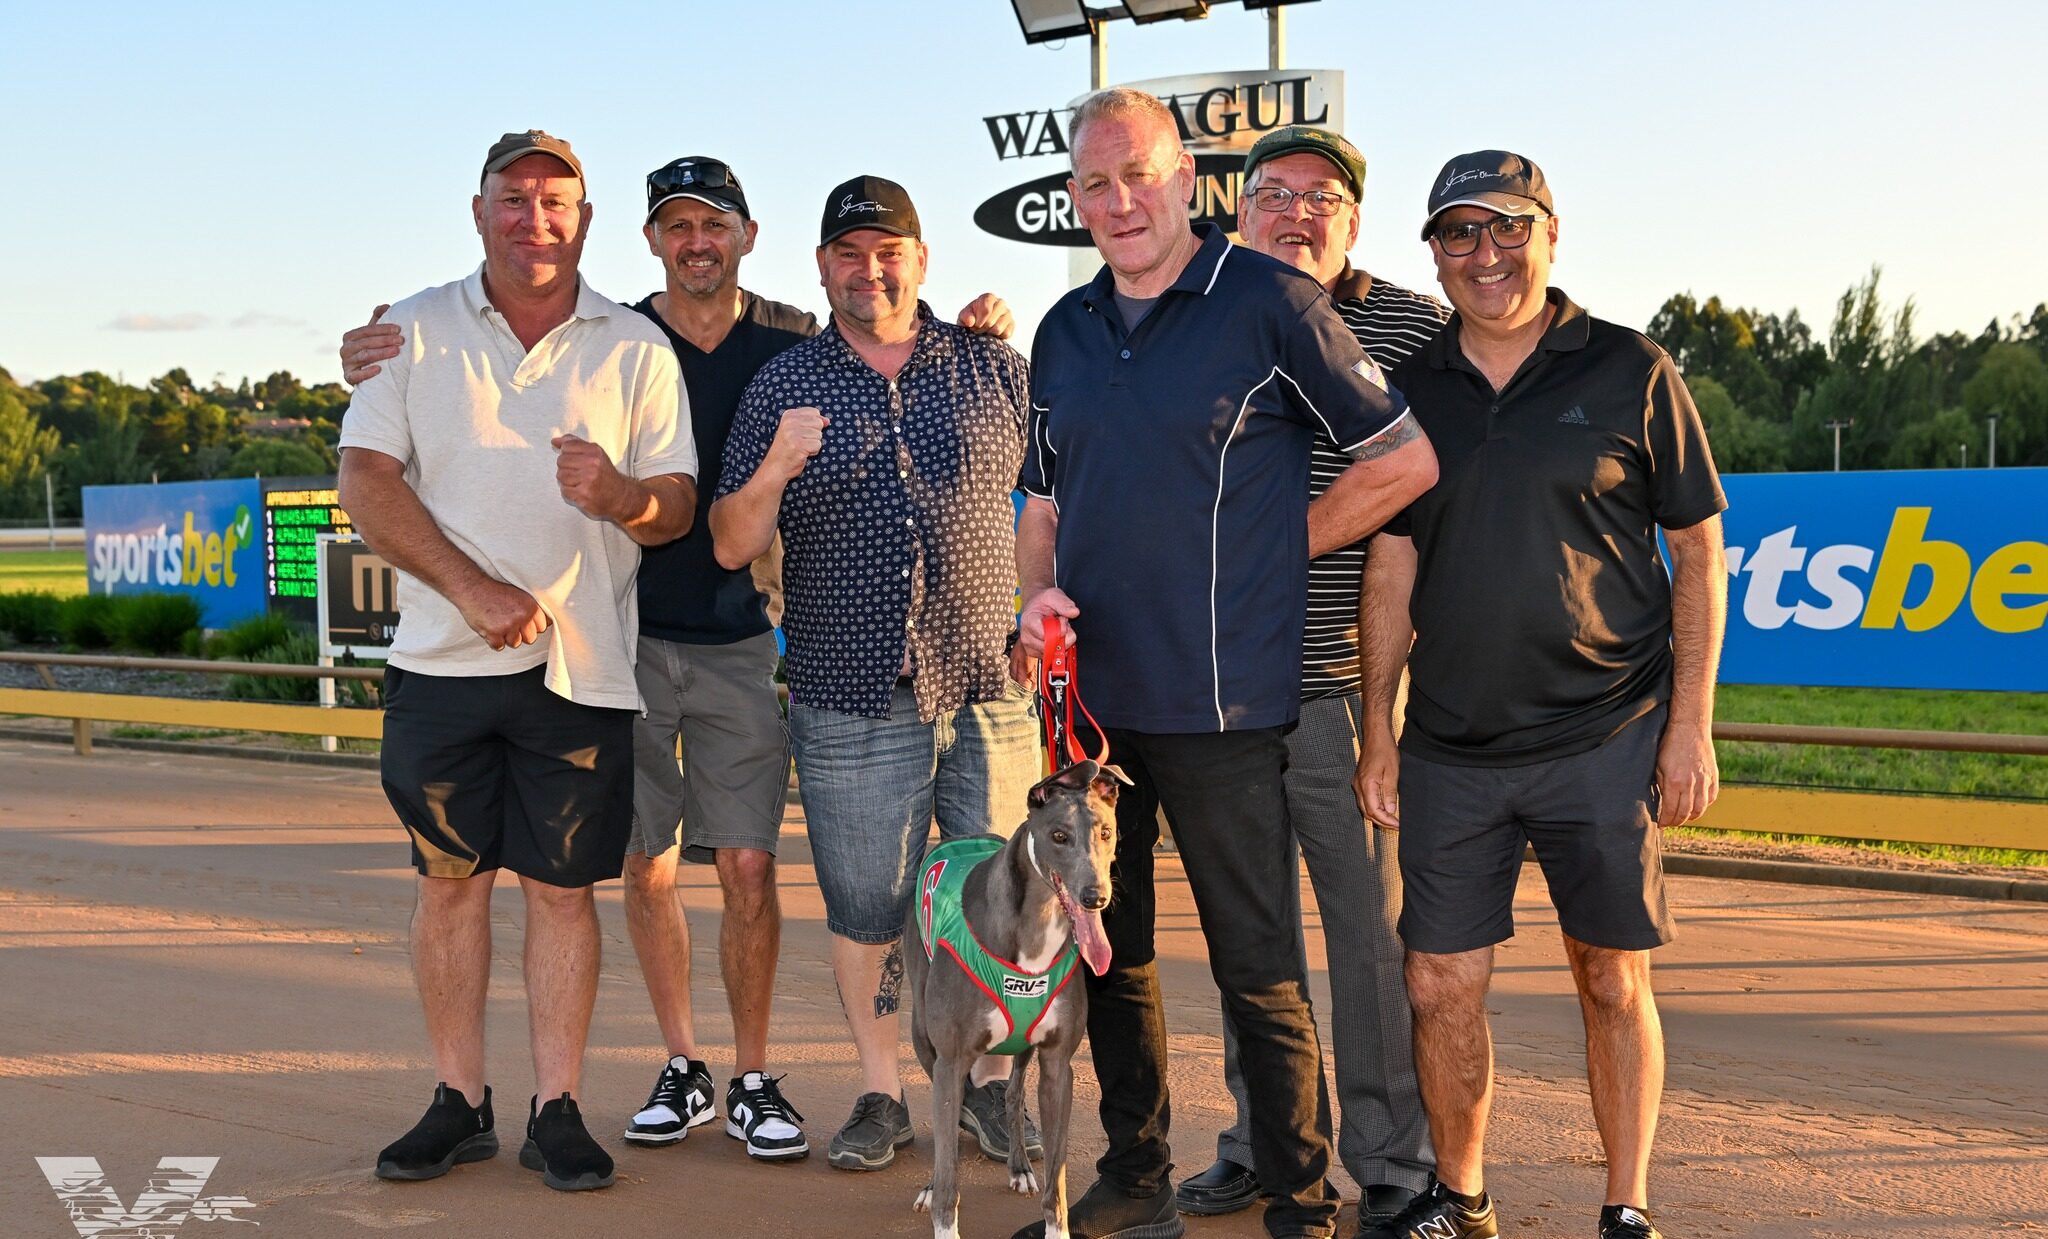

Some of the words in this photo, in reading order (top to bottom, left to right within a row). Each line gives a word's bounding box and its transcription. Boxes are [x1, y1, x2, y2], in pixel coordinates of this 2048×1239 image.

[982, 75, 1329, 161] WAAGUL
[93, 511, 238, 596] sportsbet
[1004, 977, 1037, 993] GRV
